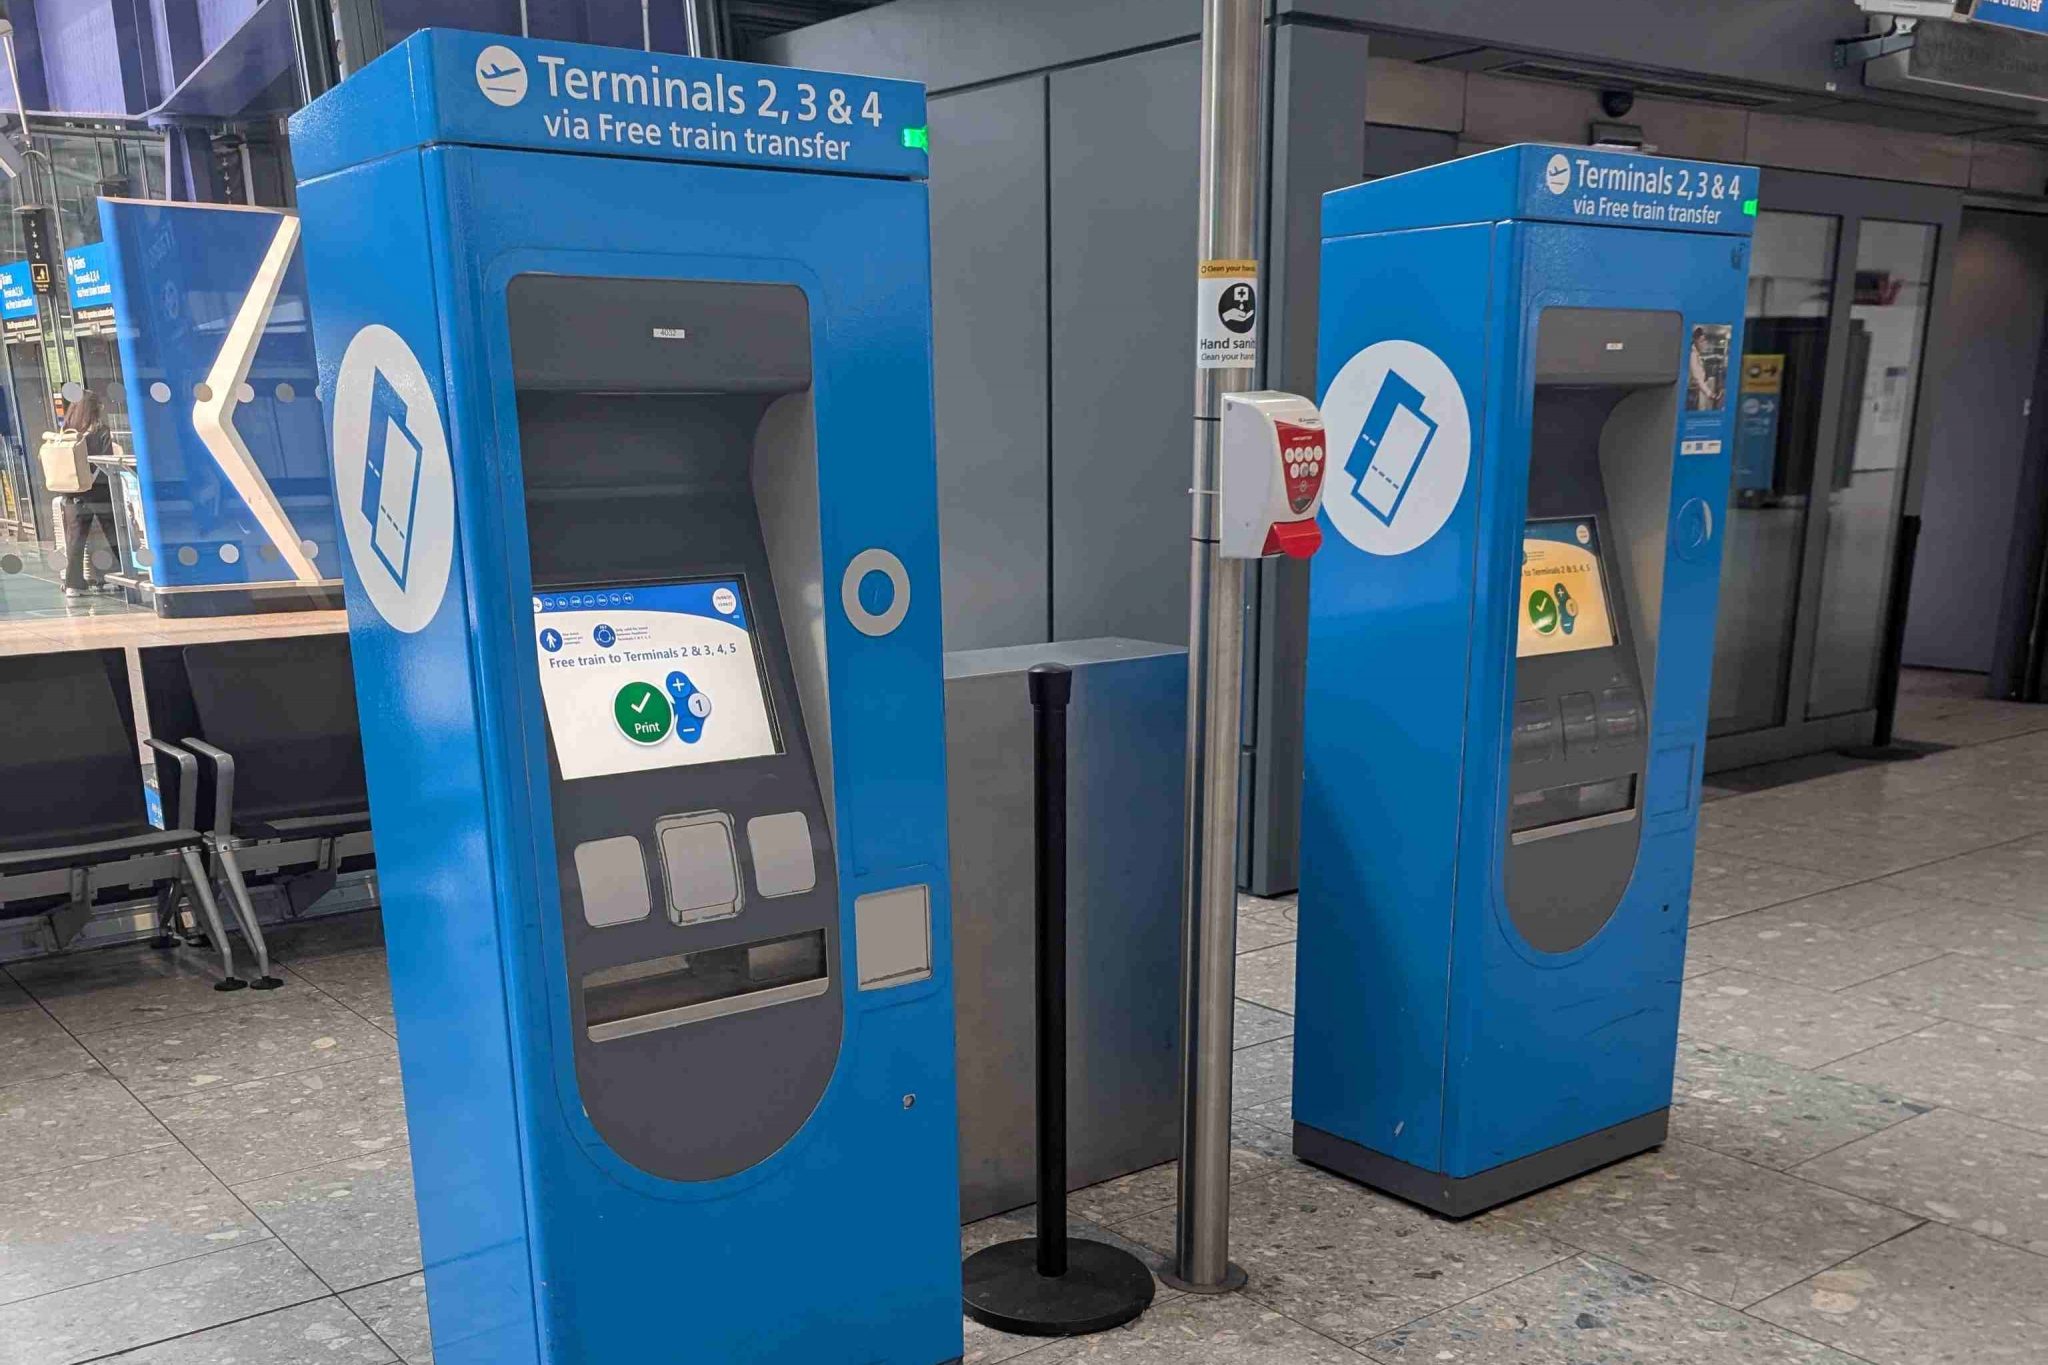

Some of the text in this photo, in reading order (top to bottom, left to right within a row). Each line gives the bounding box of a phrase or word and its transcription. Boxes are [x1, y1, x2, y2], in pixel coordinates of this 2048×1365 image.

[538, 55, 746, 116] Terminals
[827, 88, 853, 126] &
[861, 91, 884, 128] 4
[543, 109, 852, 162] via Free train transfer
[1576, 159, 1673, 196] Terminals
[1711, 174, 1725, 201] &
[1728, 175, 1741, 201] 4
[1573, 195, 1722, 225] via Free train transfer
[1207, 264, 1225, 272] Clean
[1226, 265, 1240, 274] your
[1201, 338, 1230, 350] Hand
[1201, 353, 1219, 361] Clean
[1221, 353, 1238, 362] your
[548, 642, 737, 669] Free train to Terminals 2 & 3, 4, 5
[695, 699, 703, 712] 1
[633, 721, 661, 735] Print
